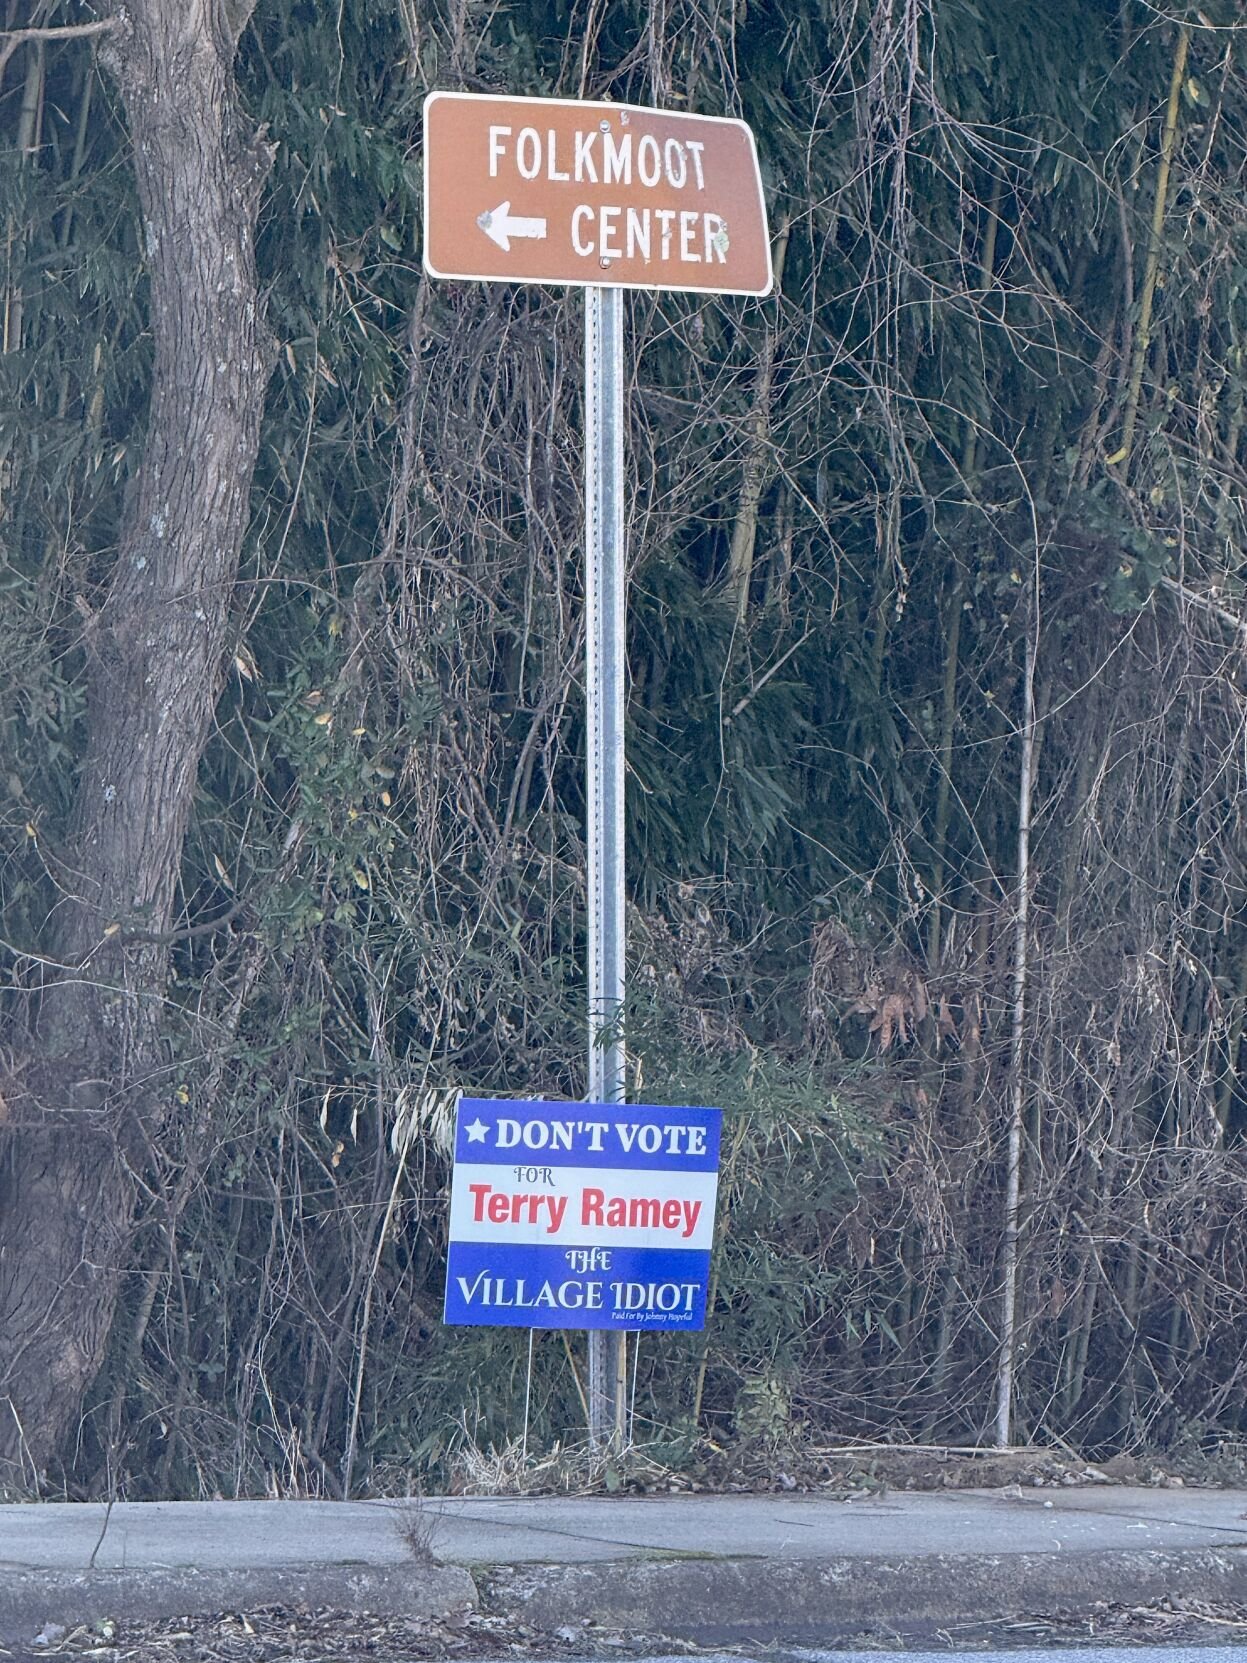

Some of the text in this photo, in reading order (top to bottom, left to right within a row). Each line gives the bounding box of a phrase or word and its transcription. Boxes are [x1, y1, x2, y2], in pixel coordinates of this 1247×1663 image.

[488, 125, 705, 190] FOLKMOOT
[571, 204, 730, 264] CENTER
[495, 1119, 707, 1155] DON'T VOTE
[513, 1166, 556, 1187] FOR
[469, 1184, 702, 1238] Terry Ramey
[565, 1247, 612, 1274] THE
[456, 1269, 700, 1311] VILLAGE IDIOT
[611, 1312, 625, 1320] Paid
[636, 1312, 644, 1321] By
